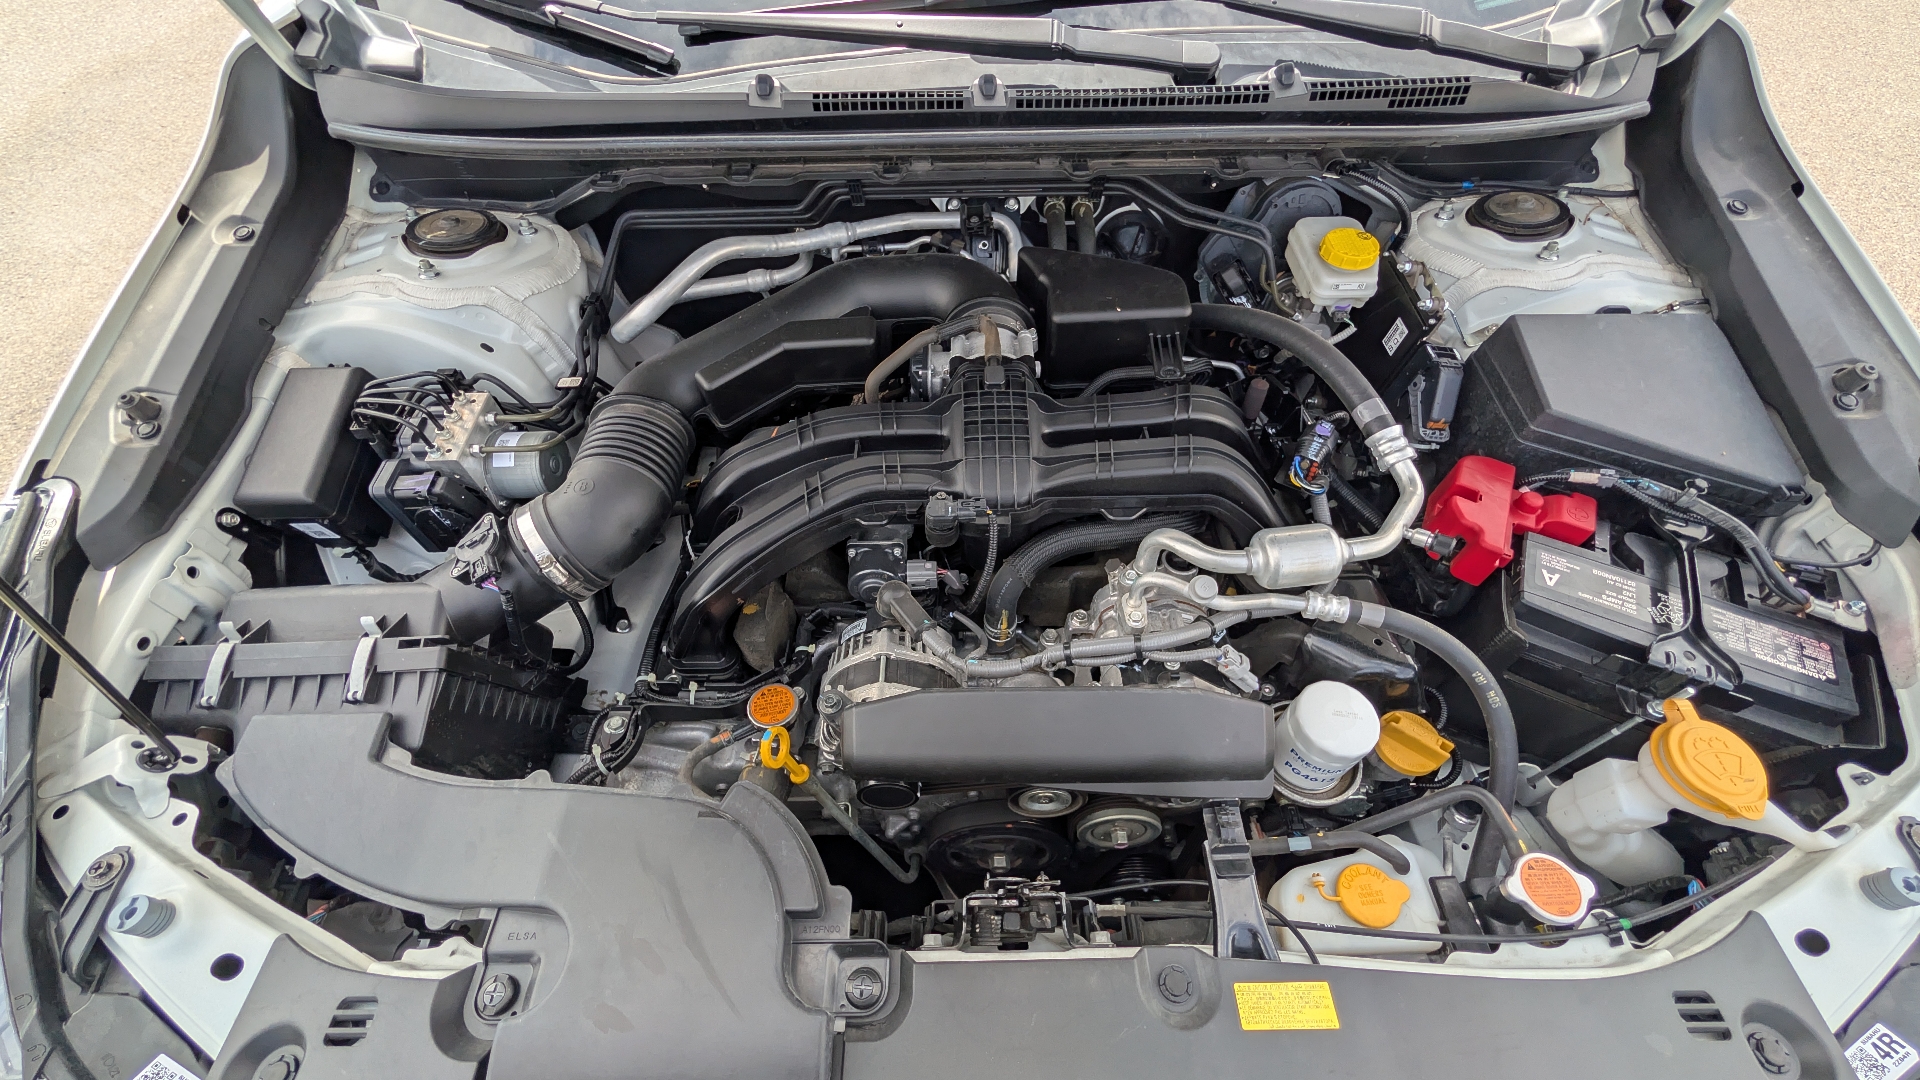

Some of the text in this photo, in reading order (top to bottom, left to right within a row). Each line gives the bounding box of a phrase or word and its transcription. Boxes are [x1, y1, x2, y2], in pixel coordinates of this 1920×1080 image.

[34, 530, 51, 561] SUBARU
[1542, 569, 1561, 586] A
[1602, 595, 1622, 605] AMPS
[1341, 867, 1389, 889] COOLANT
[508, 931, 537, 941] ELSA
[1860, 1027, 1881, 1045] SUBARU
[1871, 1033, 1906, 1060] 4R
